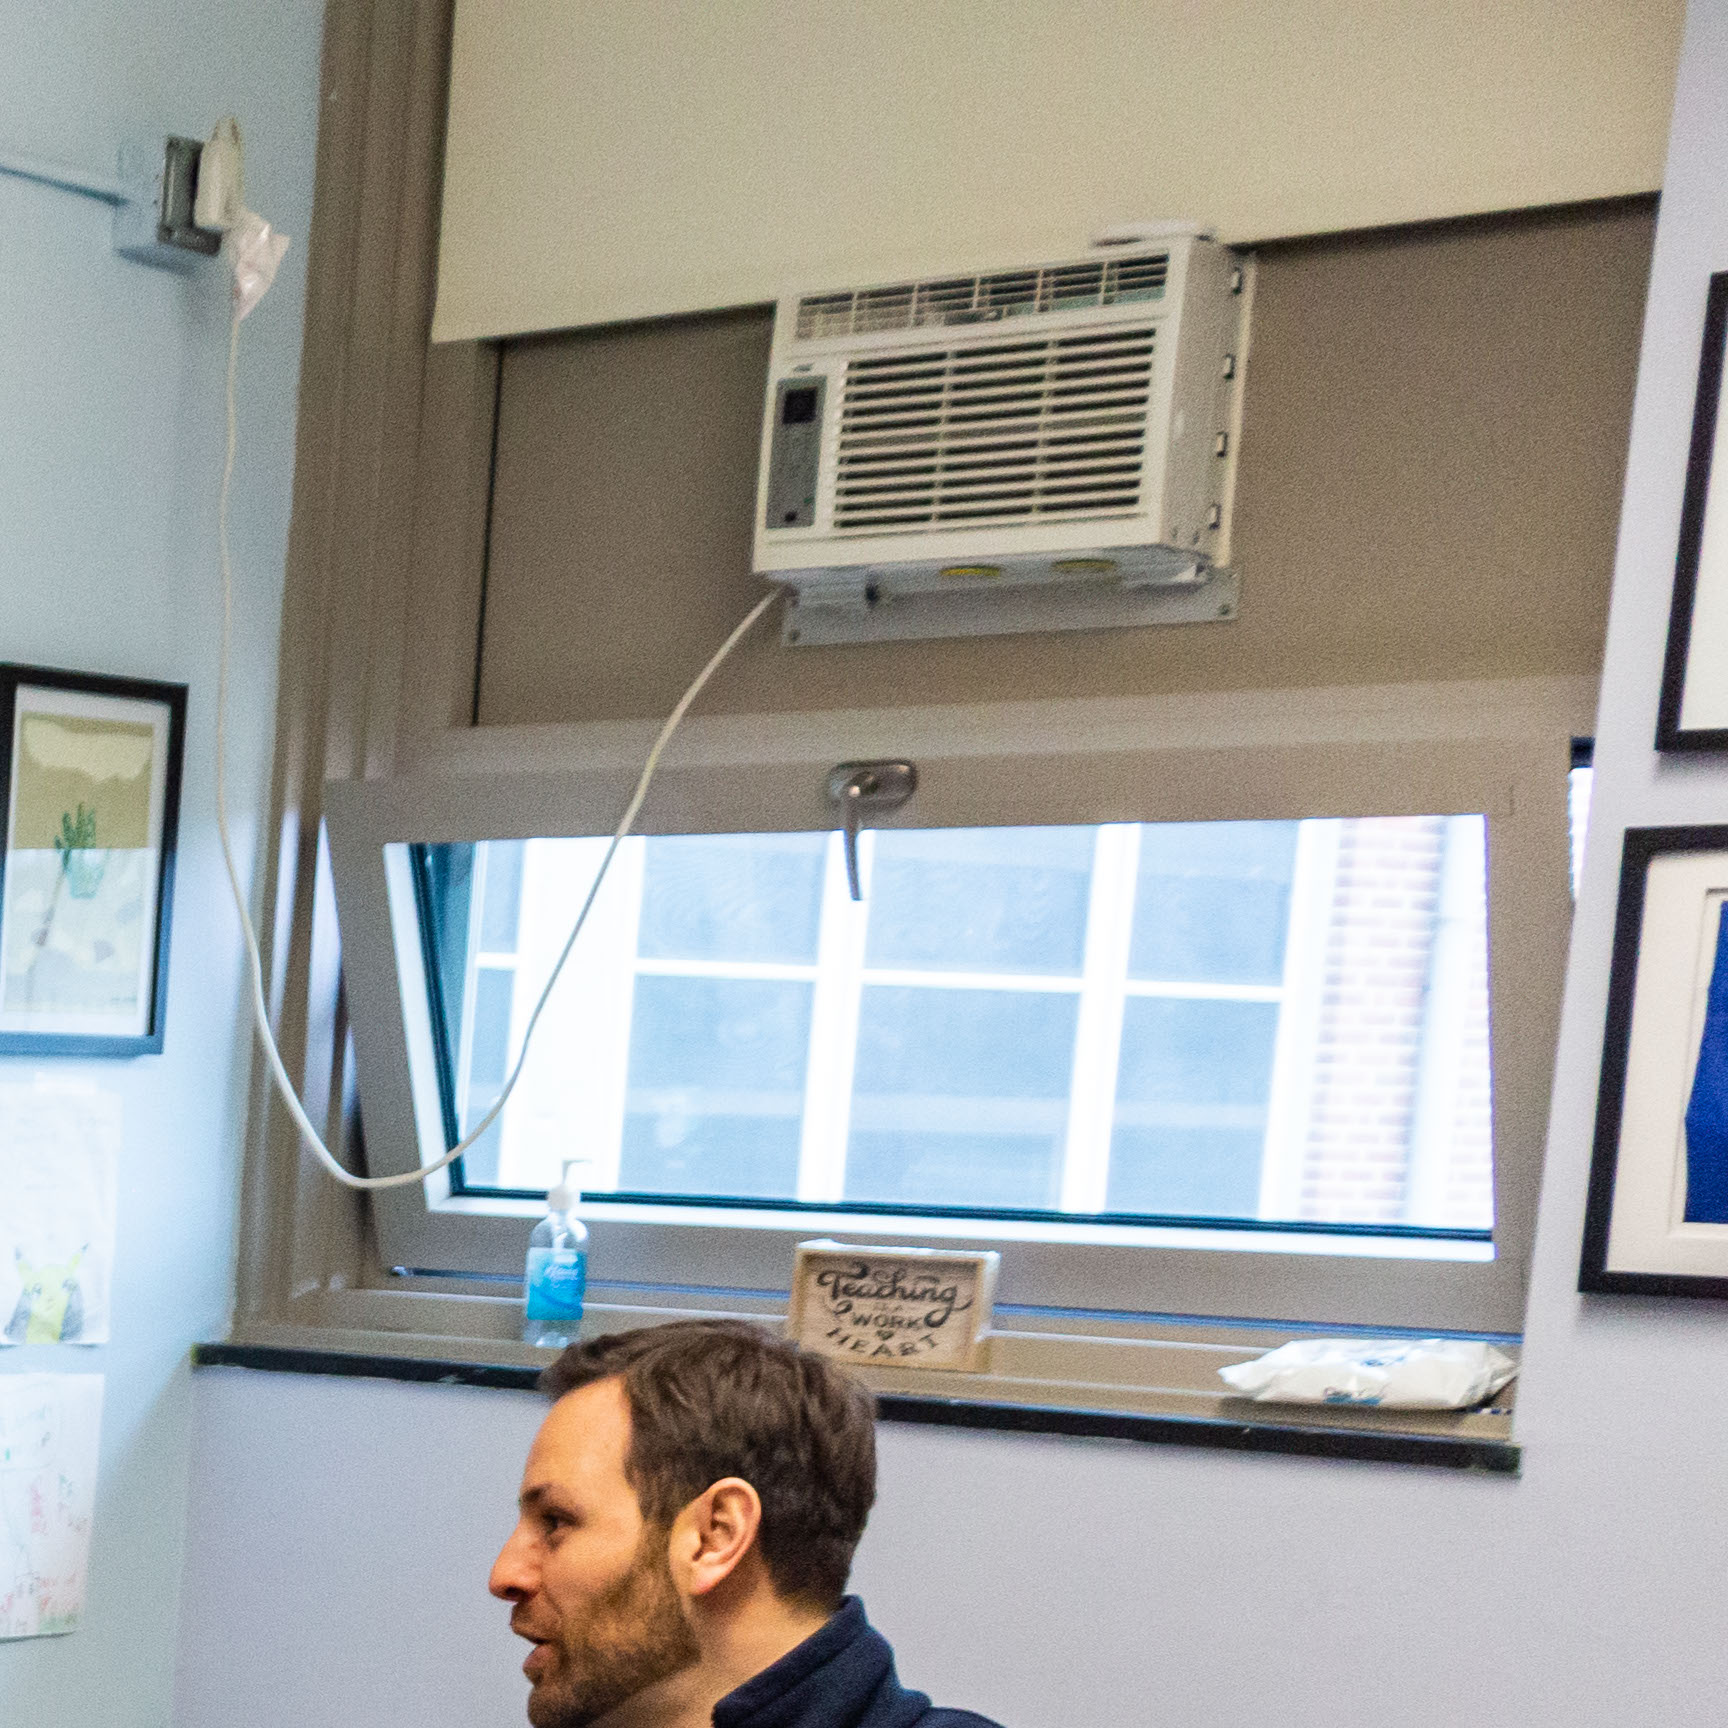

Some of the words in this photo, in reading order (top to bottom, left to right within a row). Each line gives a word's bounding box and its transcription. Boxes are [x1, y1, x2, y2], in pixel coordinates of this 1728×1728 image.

[816, 1261, 968, 1327] Teaching
[852, 1312, 923, 1330] WORK
[825, 1327, 940, 1357] HEART
